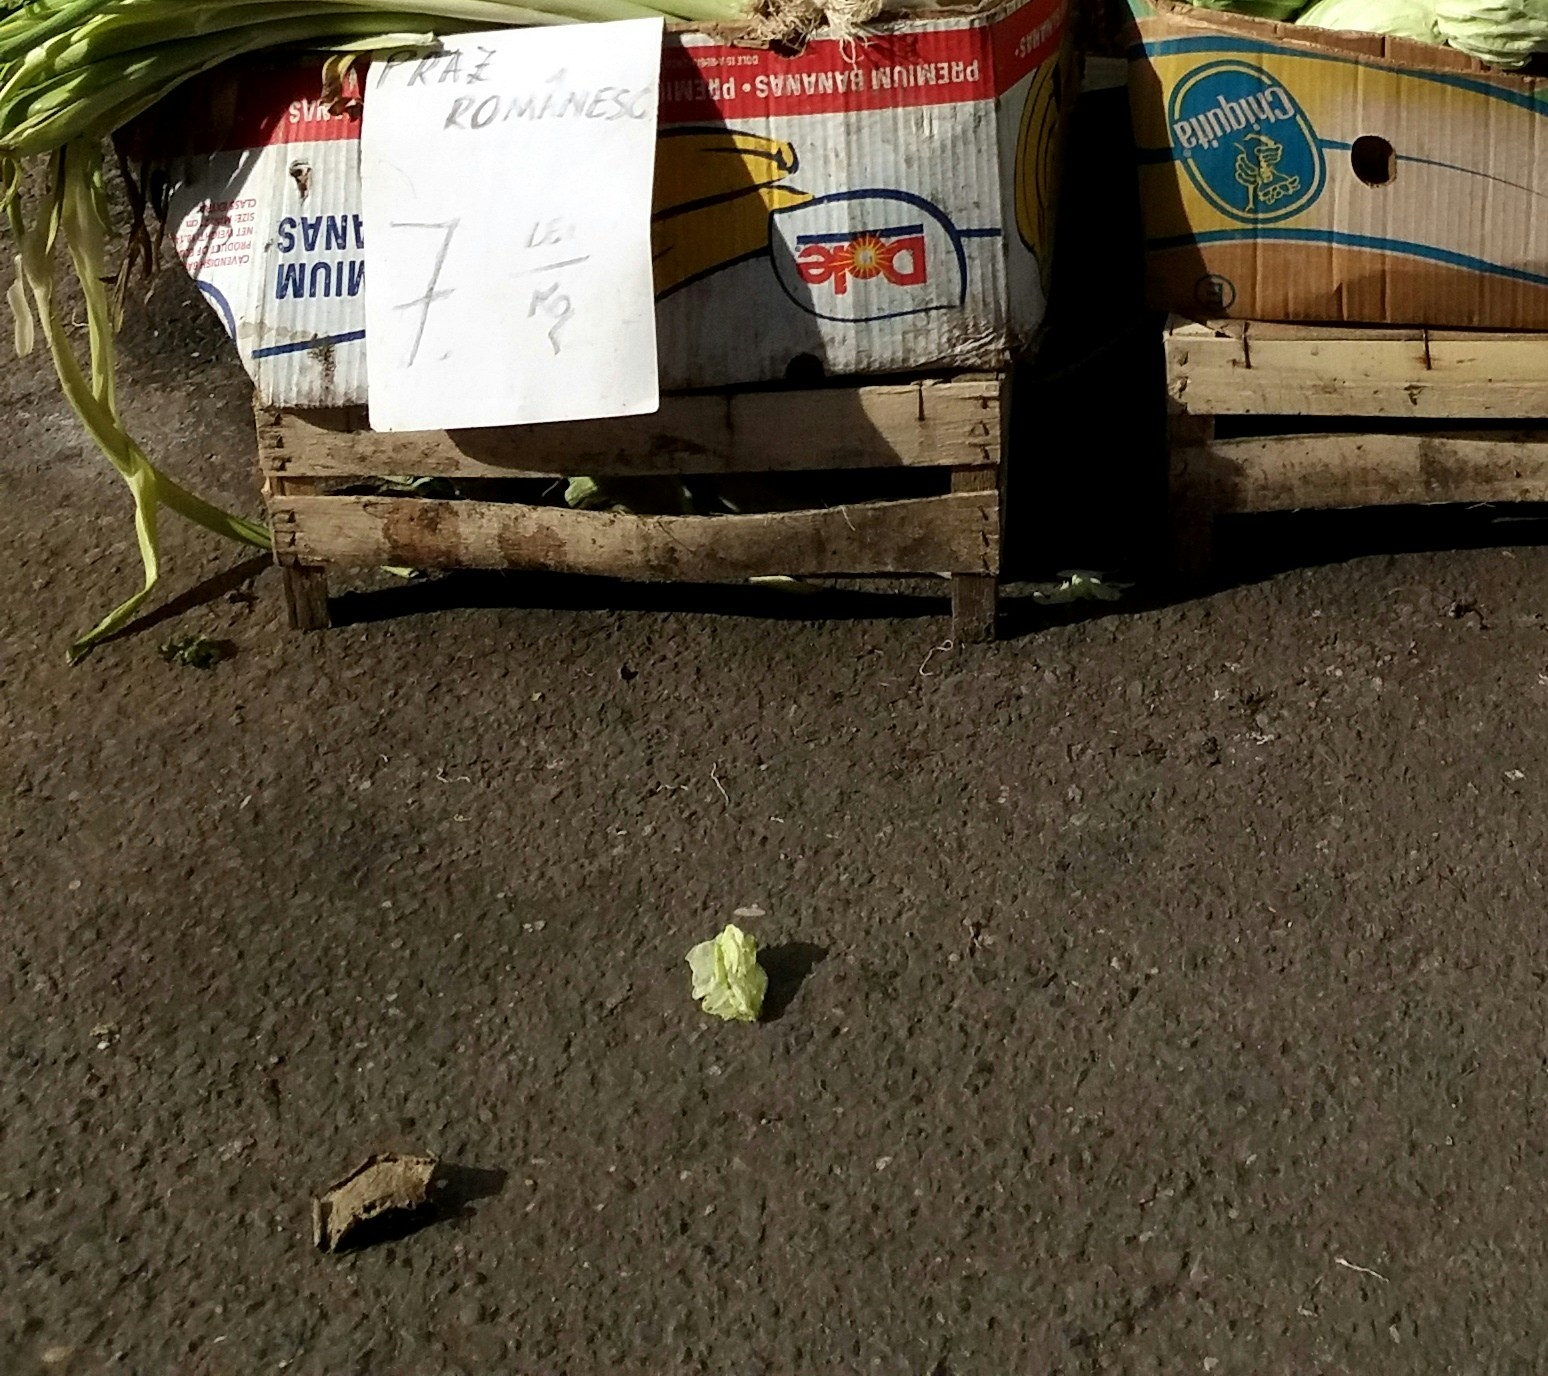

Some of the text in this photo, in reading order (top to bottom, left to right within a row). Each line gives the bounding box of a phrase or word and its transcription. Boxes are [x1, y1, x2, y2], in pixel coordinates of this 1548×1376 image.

[755, 66, 863, 99] BANANAS
[871, 59, 979, 91] PREMIUM
[1173, 87, 1295, 150] Chiquita
[796, 235, 927, 296] Dole
